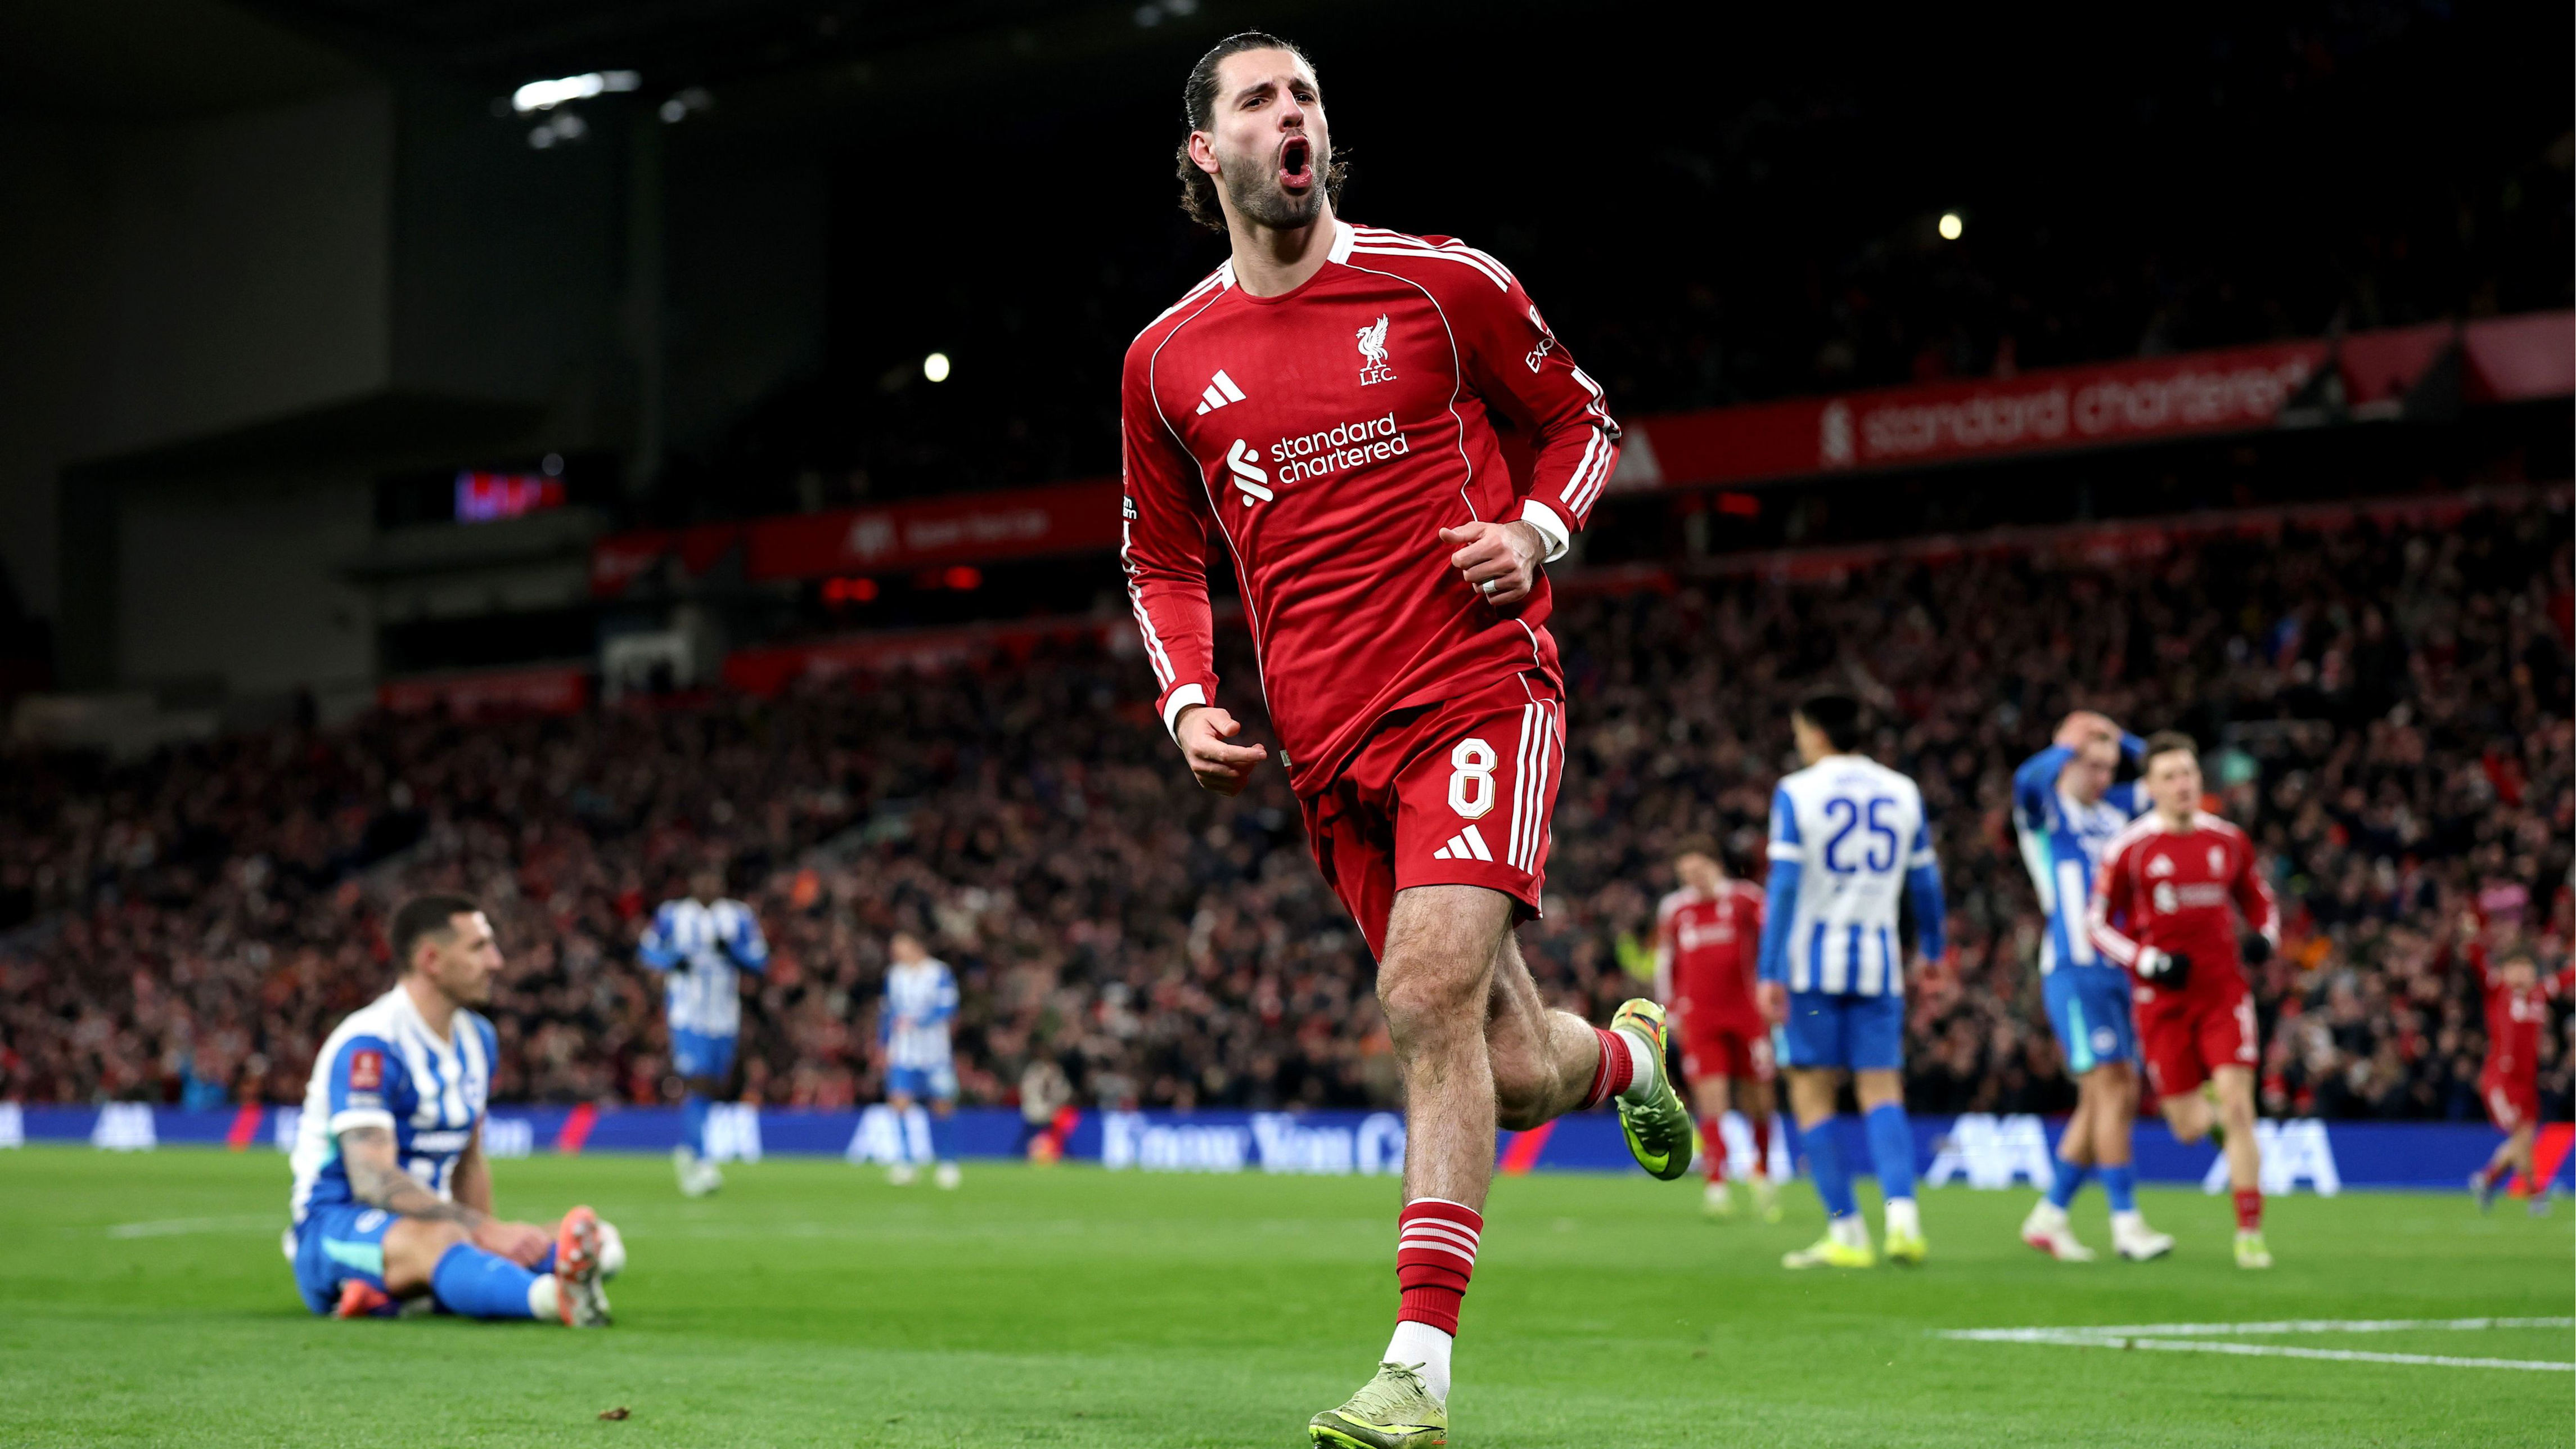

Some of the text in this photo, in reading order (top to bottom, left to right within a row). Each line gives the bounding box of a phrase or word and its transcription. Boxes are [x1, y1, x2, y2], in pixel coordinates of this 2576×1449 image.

[1359, 367, 1397, 386] L.F.C.
[1271, 411, 1397, 462] standard
[1278, 432, 1409, 484] chartered
[1447, 737, 1498, 820] 8
[1825, 797, 1898, 874] 25
